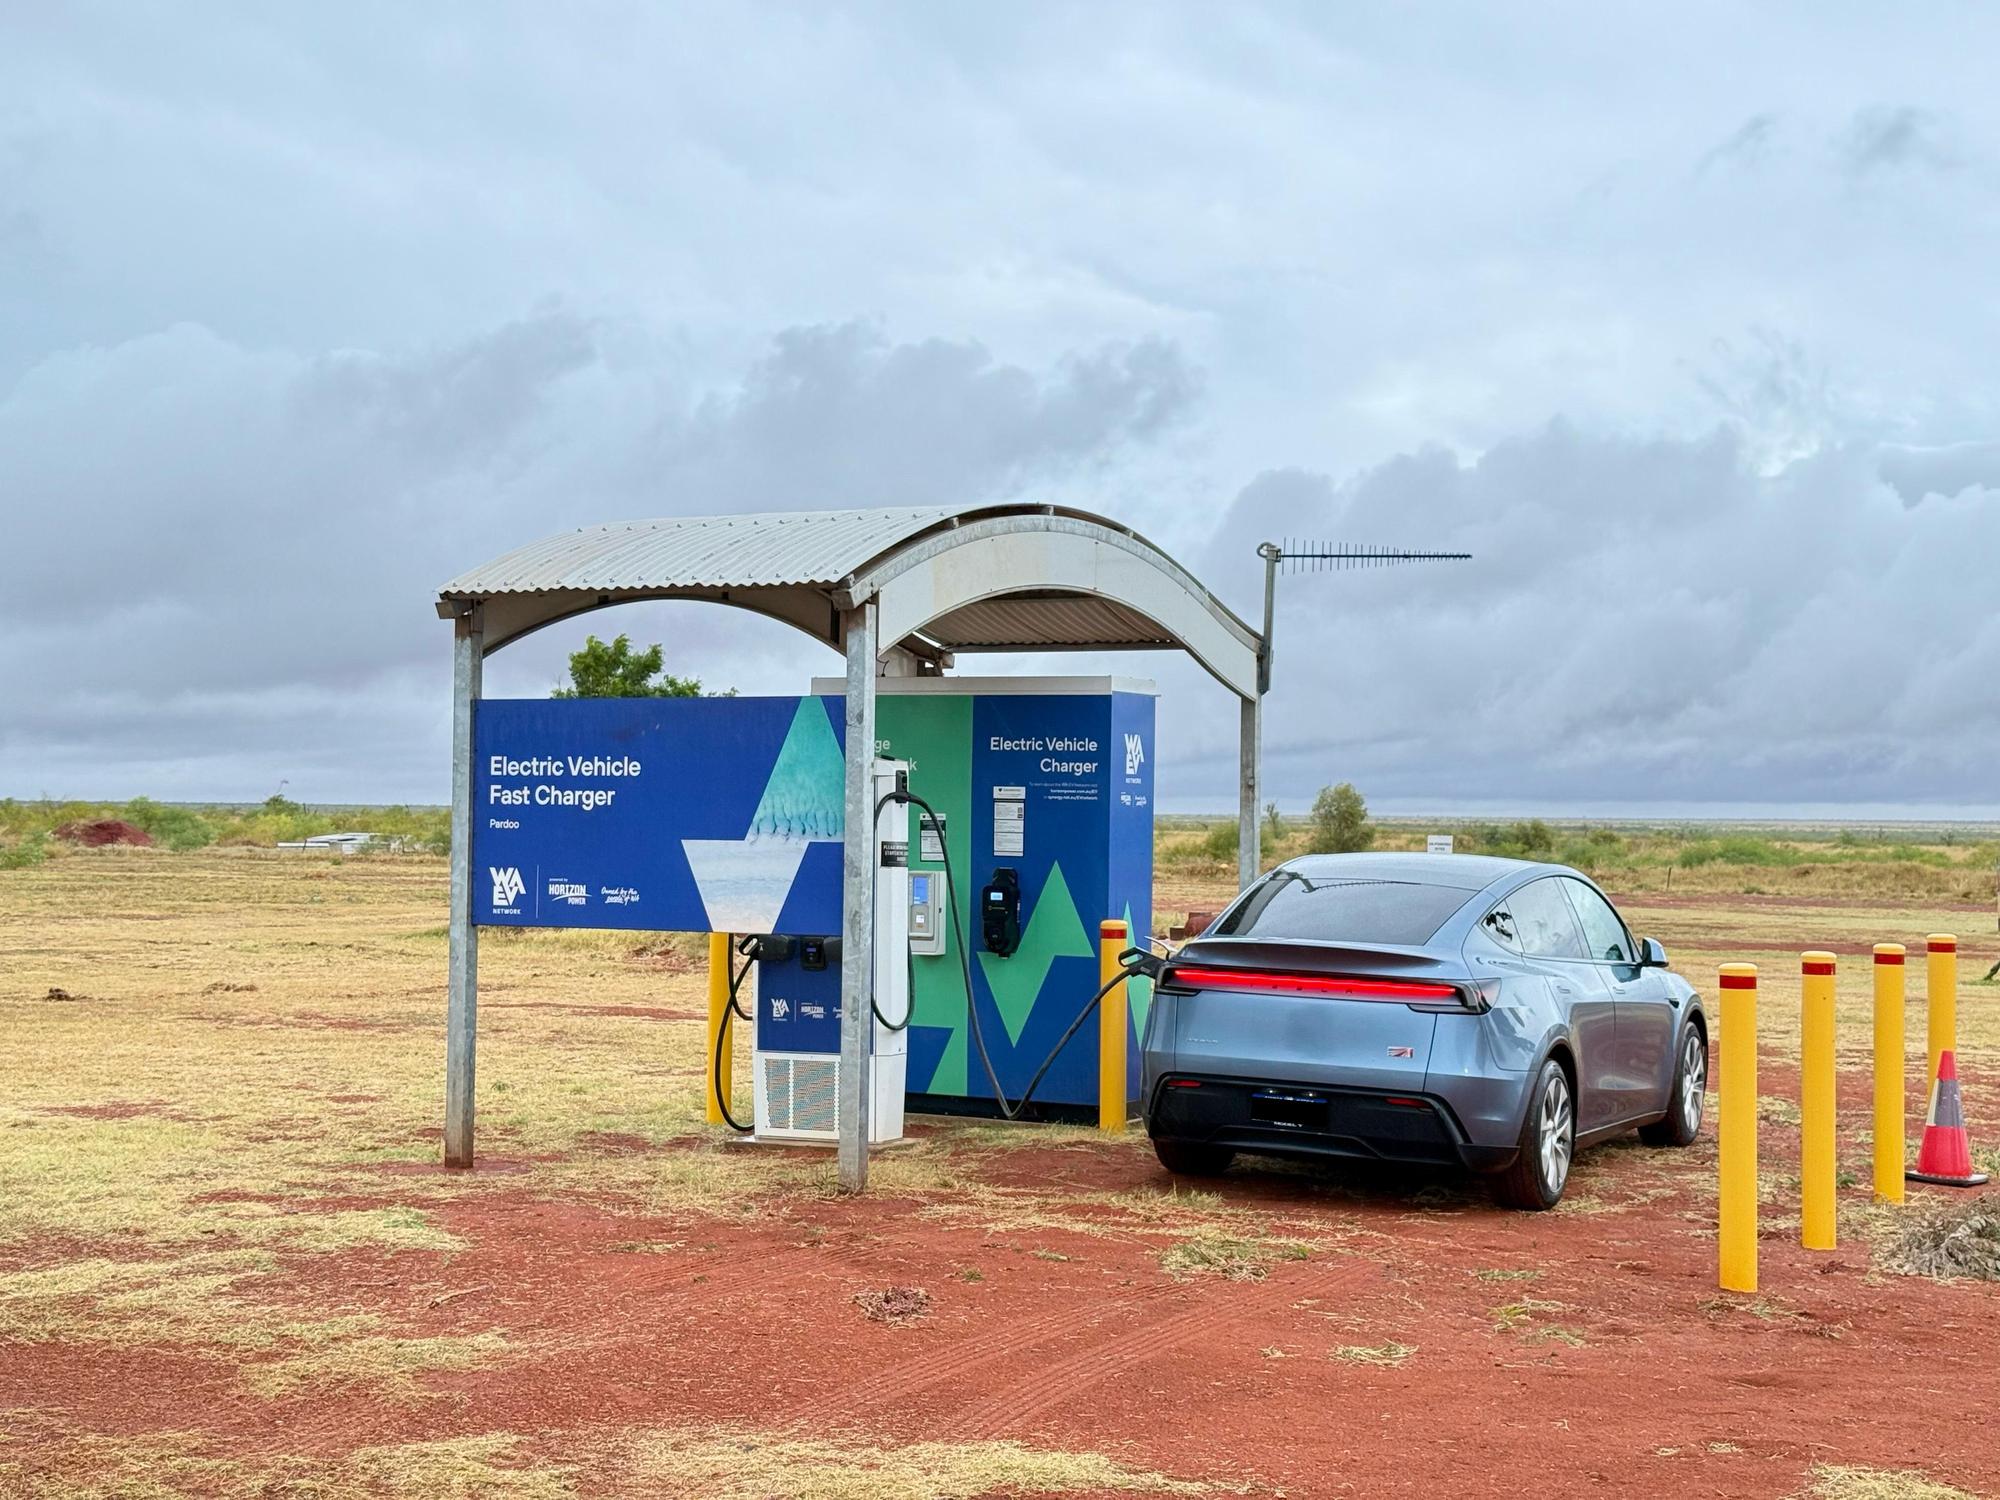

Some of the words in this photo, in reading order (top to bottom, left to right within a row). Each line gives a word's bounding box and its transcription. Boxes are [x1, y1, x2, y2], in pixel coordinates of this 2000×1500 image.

[990, 737, 1043, 751] Electric
[1045, 737, 1098, 751] Vehicle
[490, 756, 564, 776] Electric
[567, 756, 641, 776] Vehicle
[1040, 758, 1098, 776] Charger
[490, 785, 530, 805] Fast
[535, 785, 616, 811] Charger
[489, 819, 520, 829] Pardoo
[548, 883, 586, 895] HORIZON
[567, 897, 586, 905] POWER
